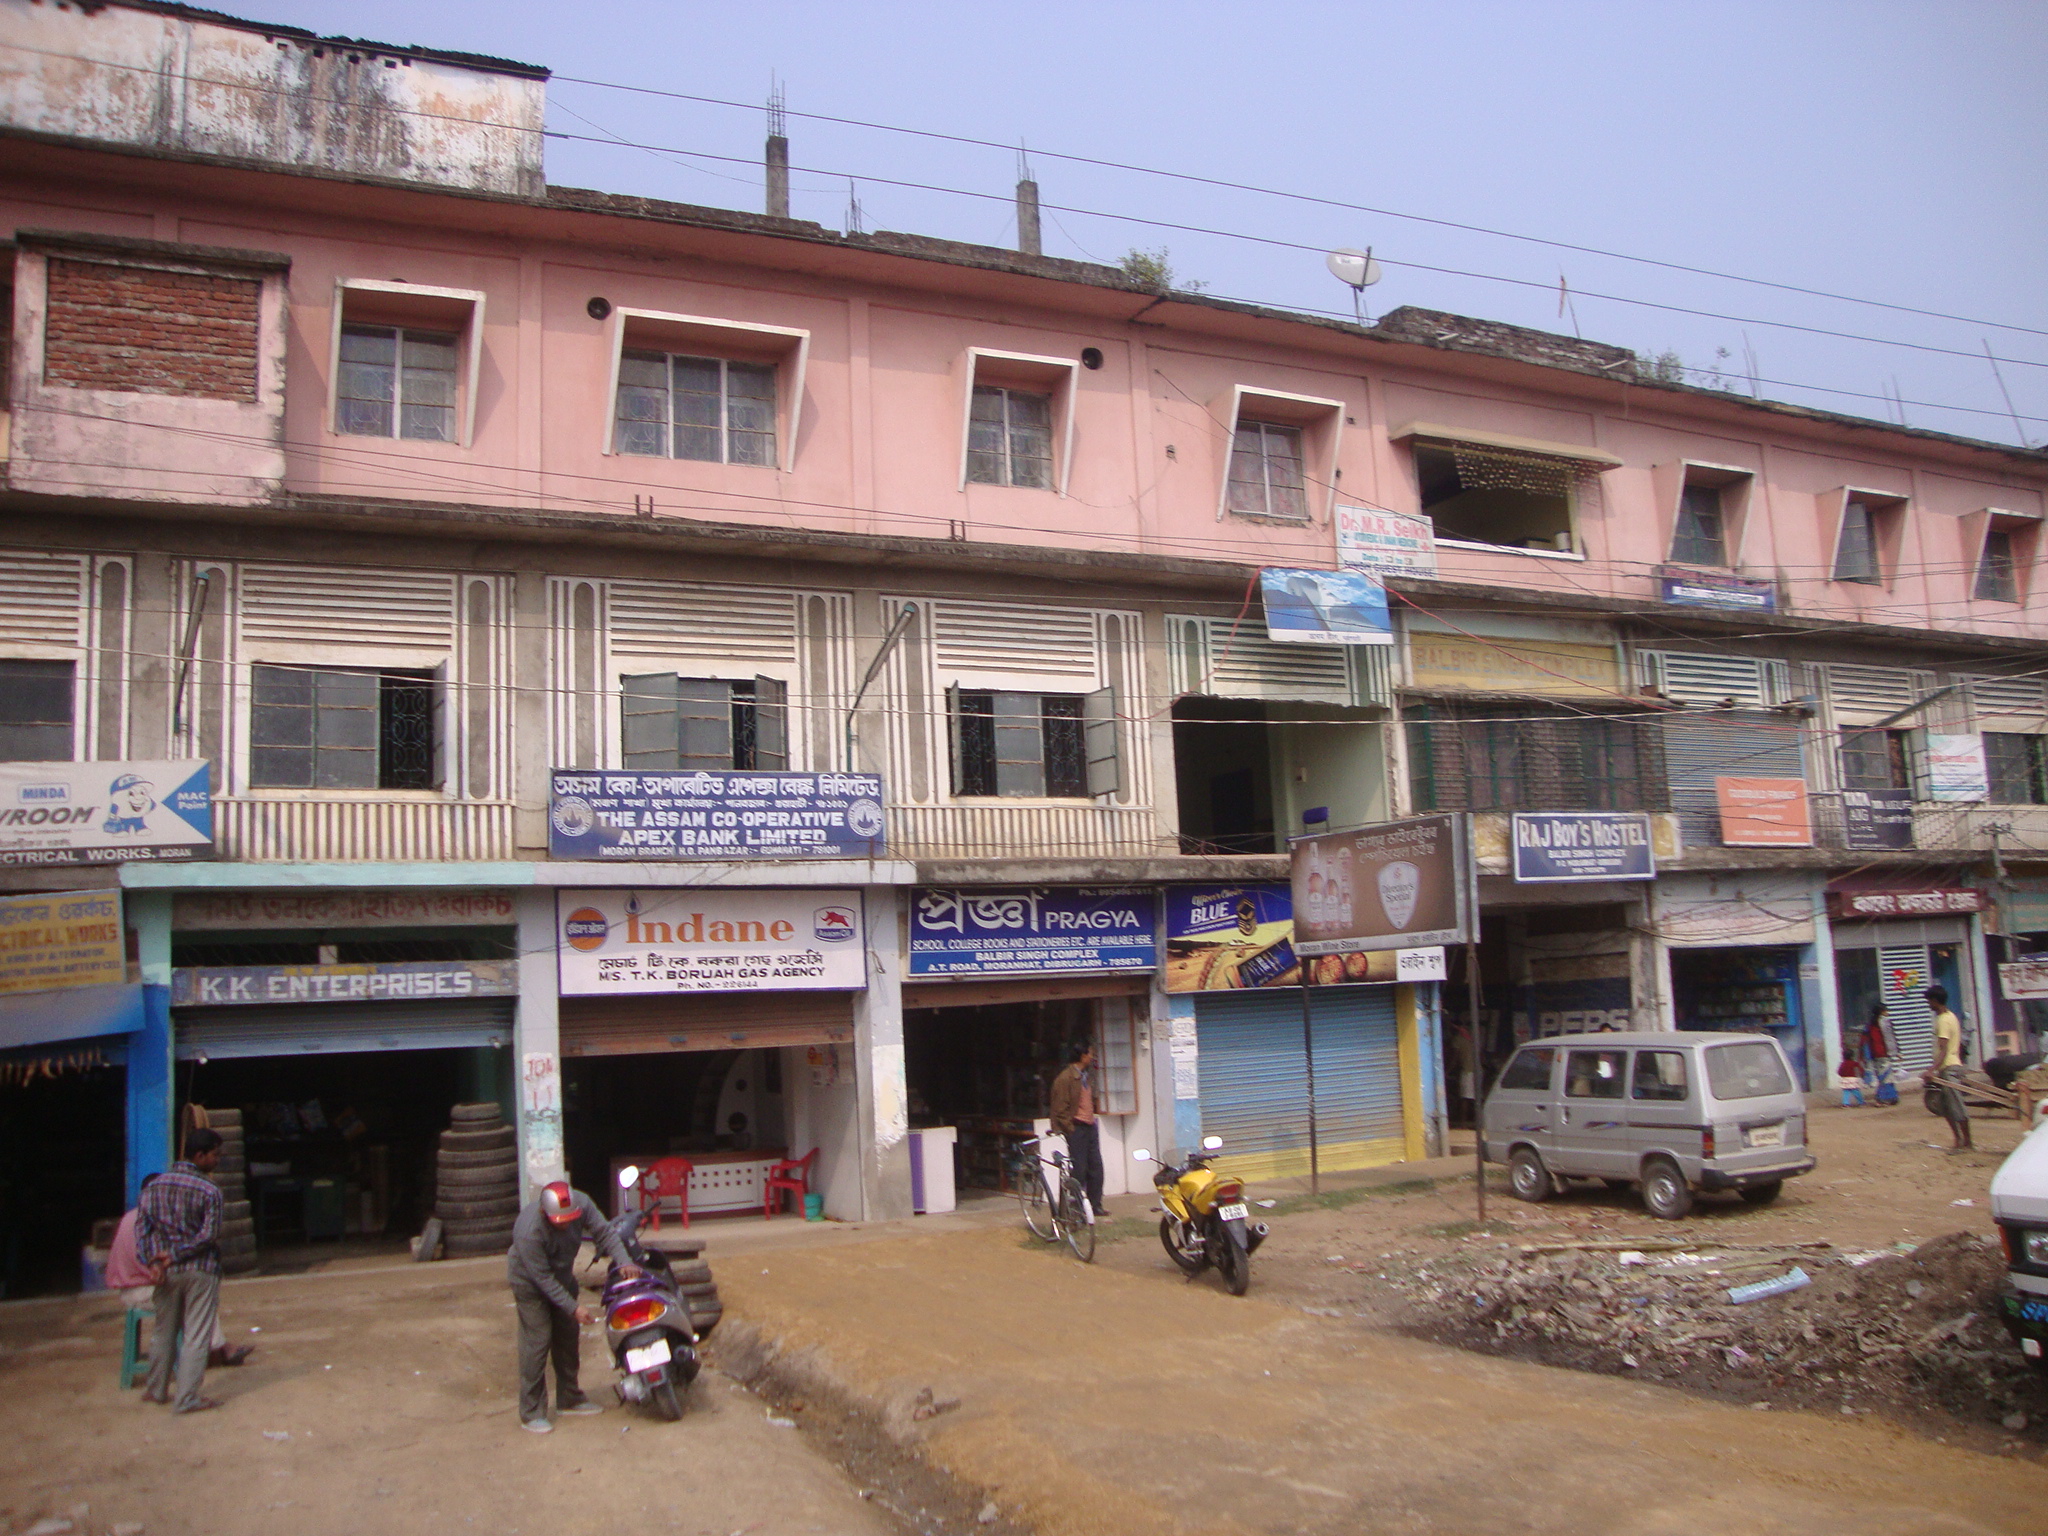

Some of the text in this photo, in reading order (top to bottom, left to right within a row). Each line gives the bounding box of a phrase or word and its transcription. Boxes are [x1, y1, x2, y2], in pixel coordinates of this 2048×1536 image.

[22, 787, 65, 799] MINDA
[177, 792, 207, 801] MAC
[178, 801, 207, 810] Point
[596, 811, 636, 827] THE
[642, 811, 706, 827] ASSAM
[711, 811, 844, 827] CO-OPERATIVE
[618, 829, 827, 846] APEX BANK LIMITED
[1519, 820, 1550, 847] RAJ
[1591, 819, 1647, 847] HOSTEL
[1045, 910, 1140, 930] PRAGYA
[1190, 901, 1230, 925] BLUE
[625, 912, 795, 943] Indane
[948, 938, 982, 949] COLLEGE
[983, 938, 1008, 948] BOOKS
[1009, 938, 1026, 948] AND
[975, 949, 1099, 961] BALBIR SINGH COMPLEX
[667, 969, 734, 980] BORUAH
[738, 968, 768, 978] GAS
[772, 967, 825, 978] AGENCY
[268, 972, 472, 999] ENTERPRISES
